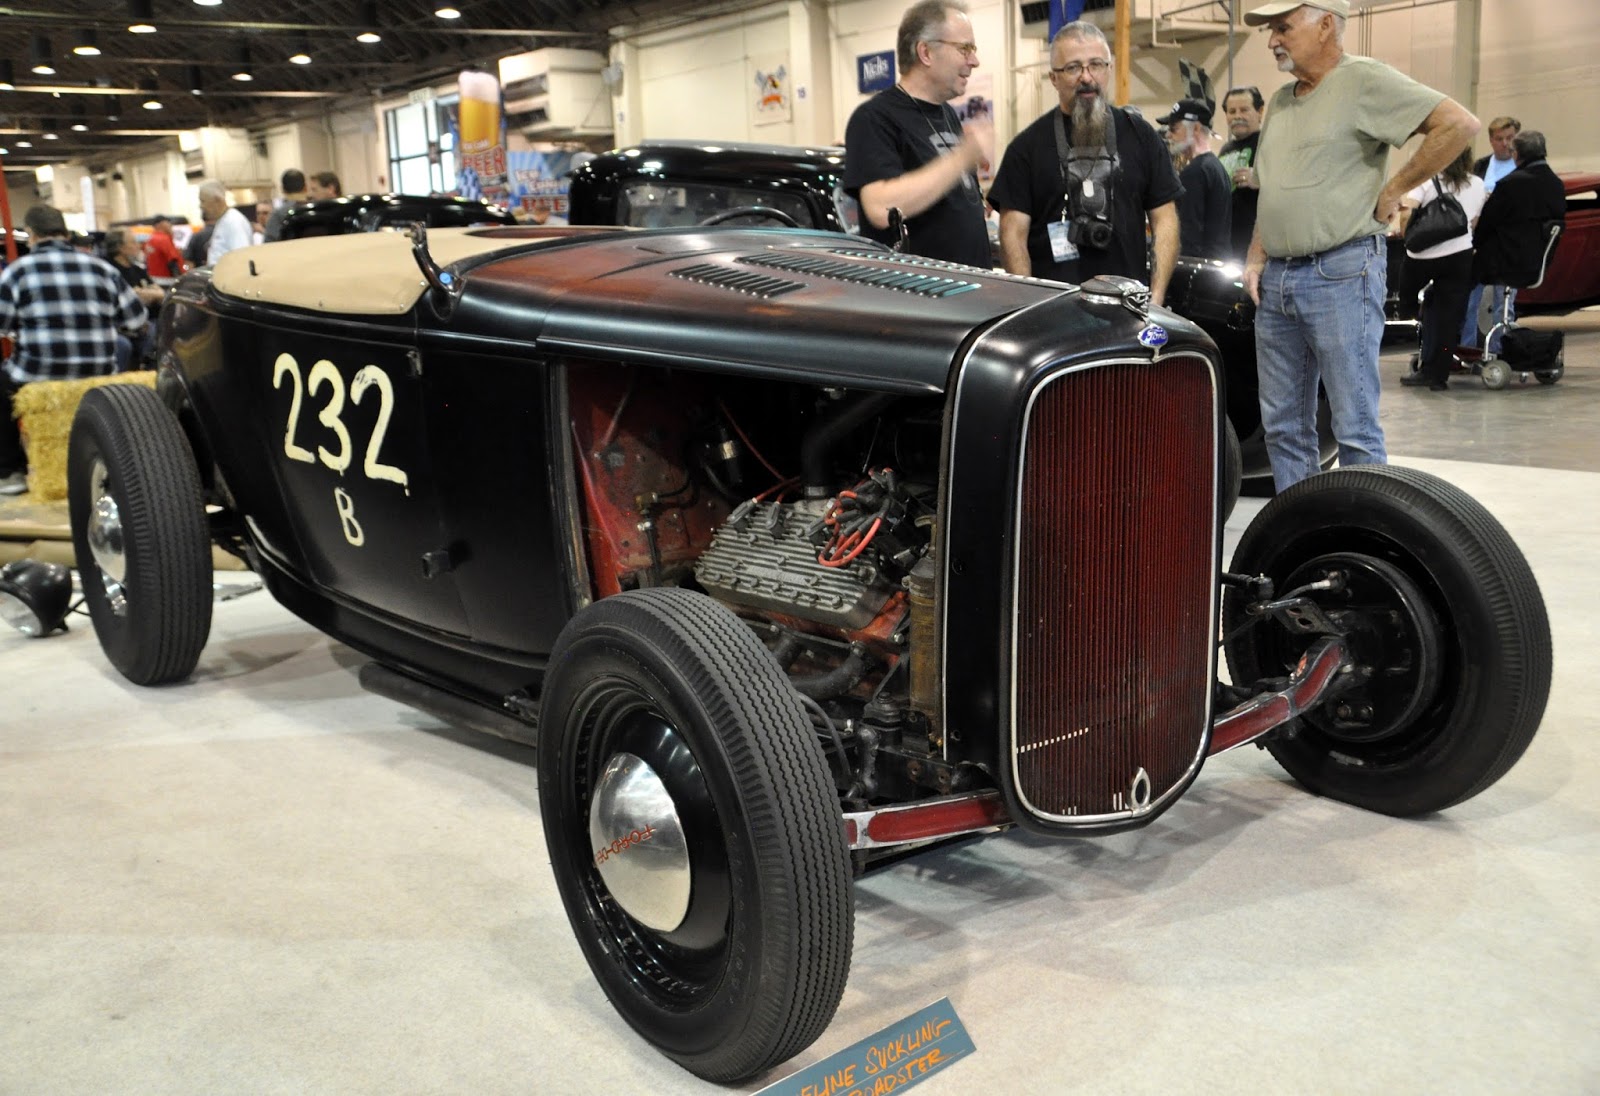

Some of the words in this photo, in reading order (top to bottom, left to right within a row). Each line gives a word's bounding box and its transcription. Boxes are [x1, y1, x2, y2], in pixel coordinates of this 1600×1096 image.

[462, 146, 506, 176] BEER
[273, 353, 410, 492] 232
[334, 487, 364, 546] B
[865, 1016, 951, 1074] SUCKLING
